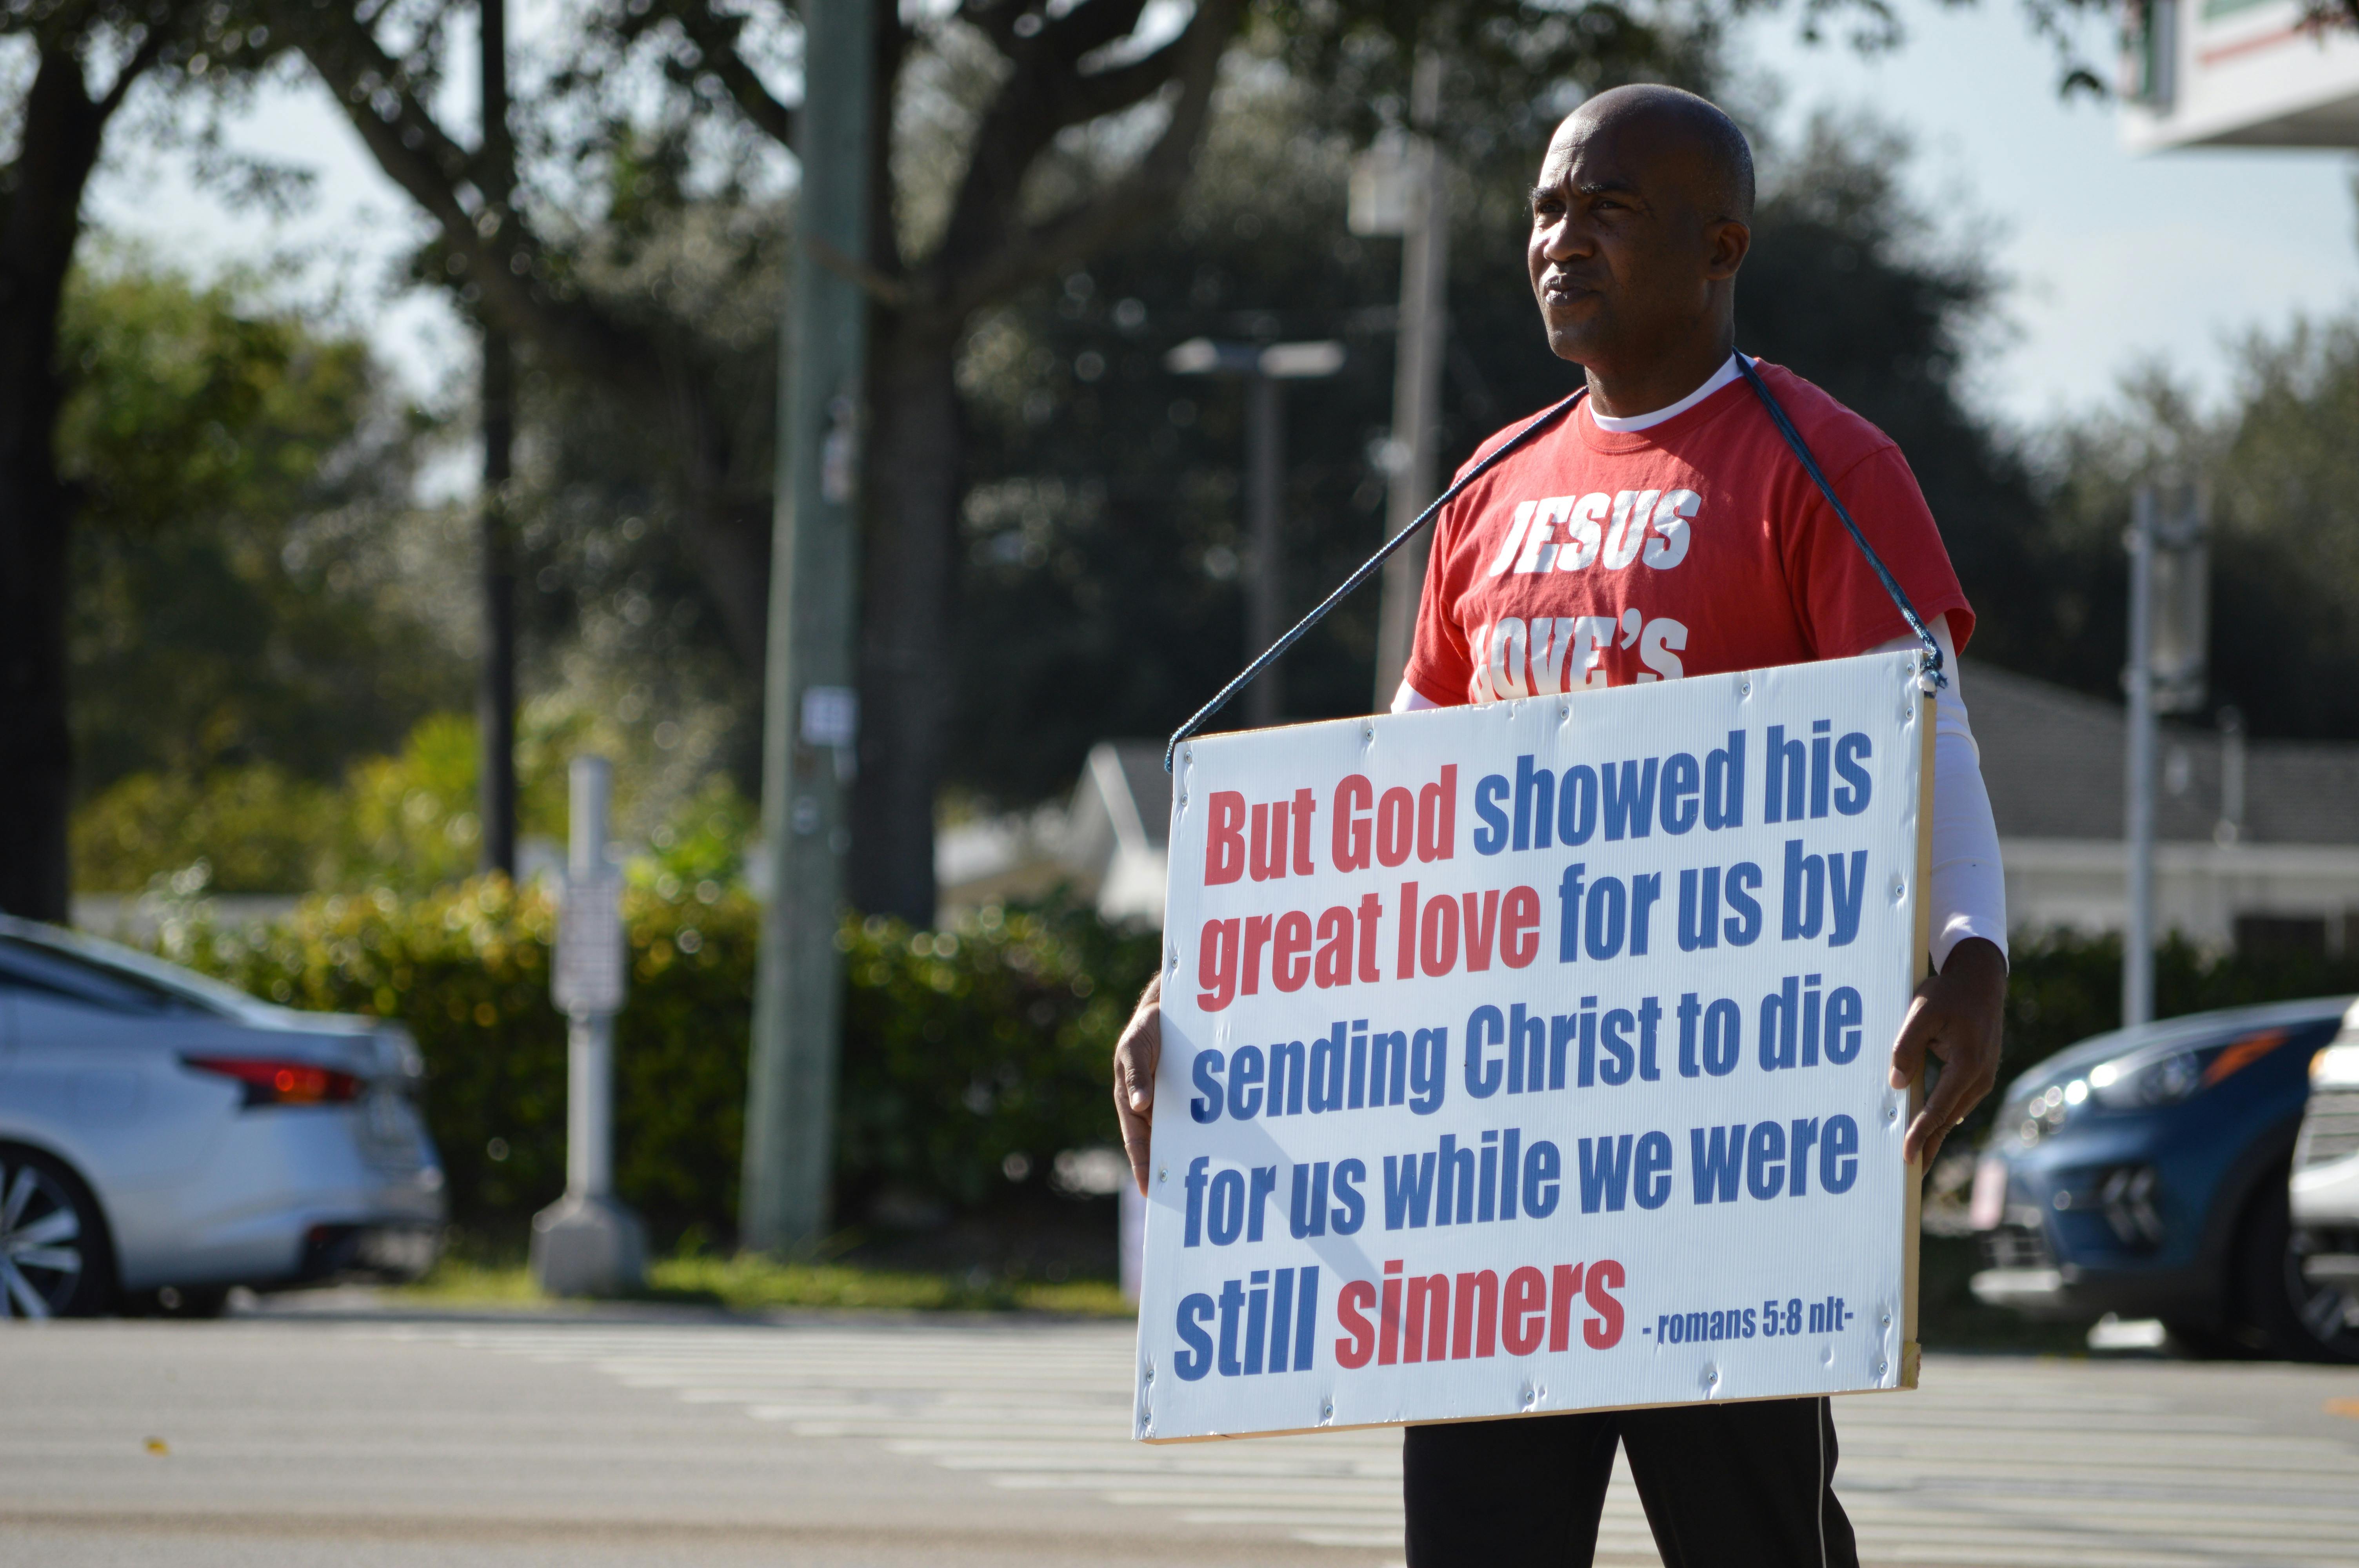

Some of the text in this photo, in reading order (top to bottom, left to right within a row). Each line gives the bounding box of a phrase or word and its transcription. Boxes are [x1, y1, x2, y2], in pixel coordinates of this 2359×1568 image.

[1489, 489, 1701, 577] JESUS
[1206, 720, 1872, 885] But God showed his
[1198, 840, 1868, 1011] great love for us by
[1190, 974, 1862, 1124] sending Christ to die
[1184, 1114, 1858, 1247] for us while we were
[1174, 1260, 1624, 1380] still sinners
[1657, 1308, 1756, 1345] romans
[1763, 1298, 1802, 1337] 5:8
